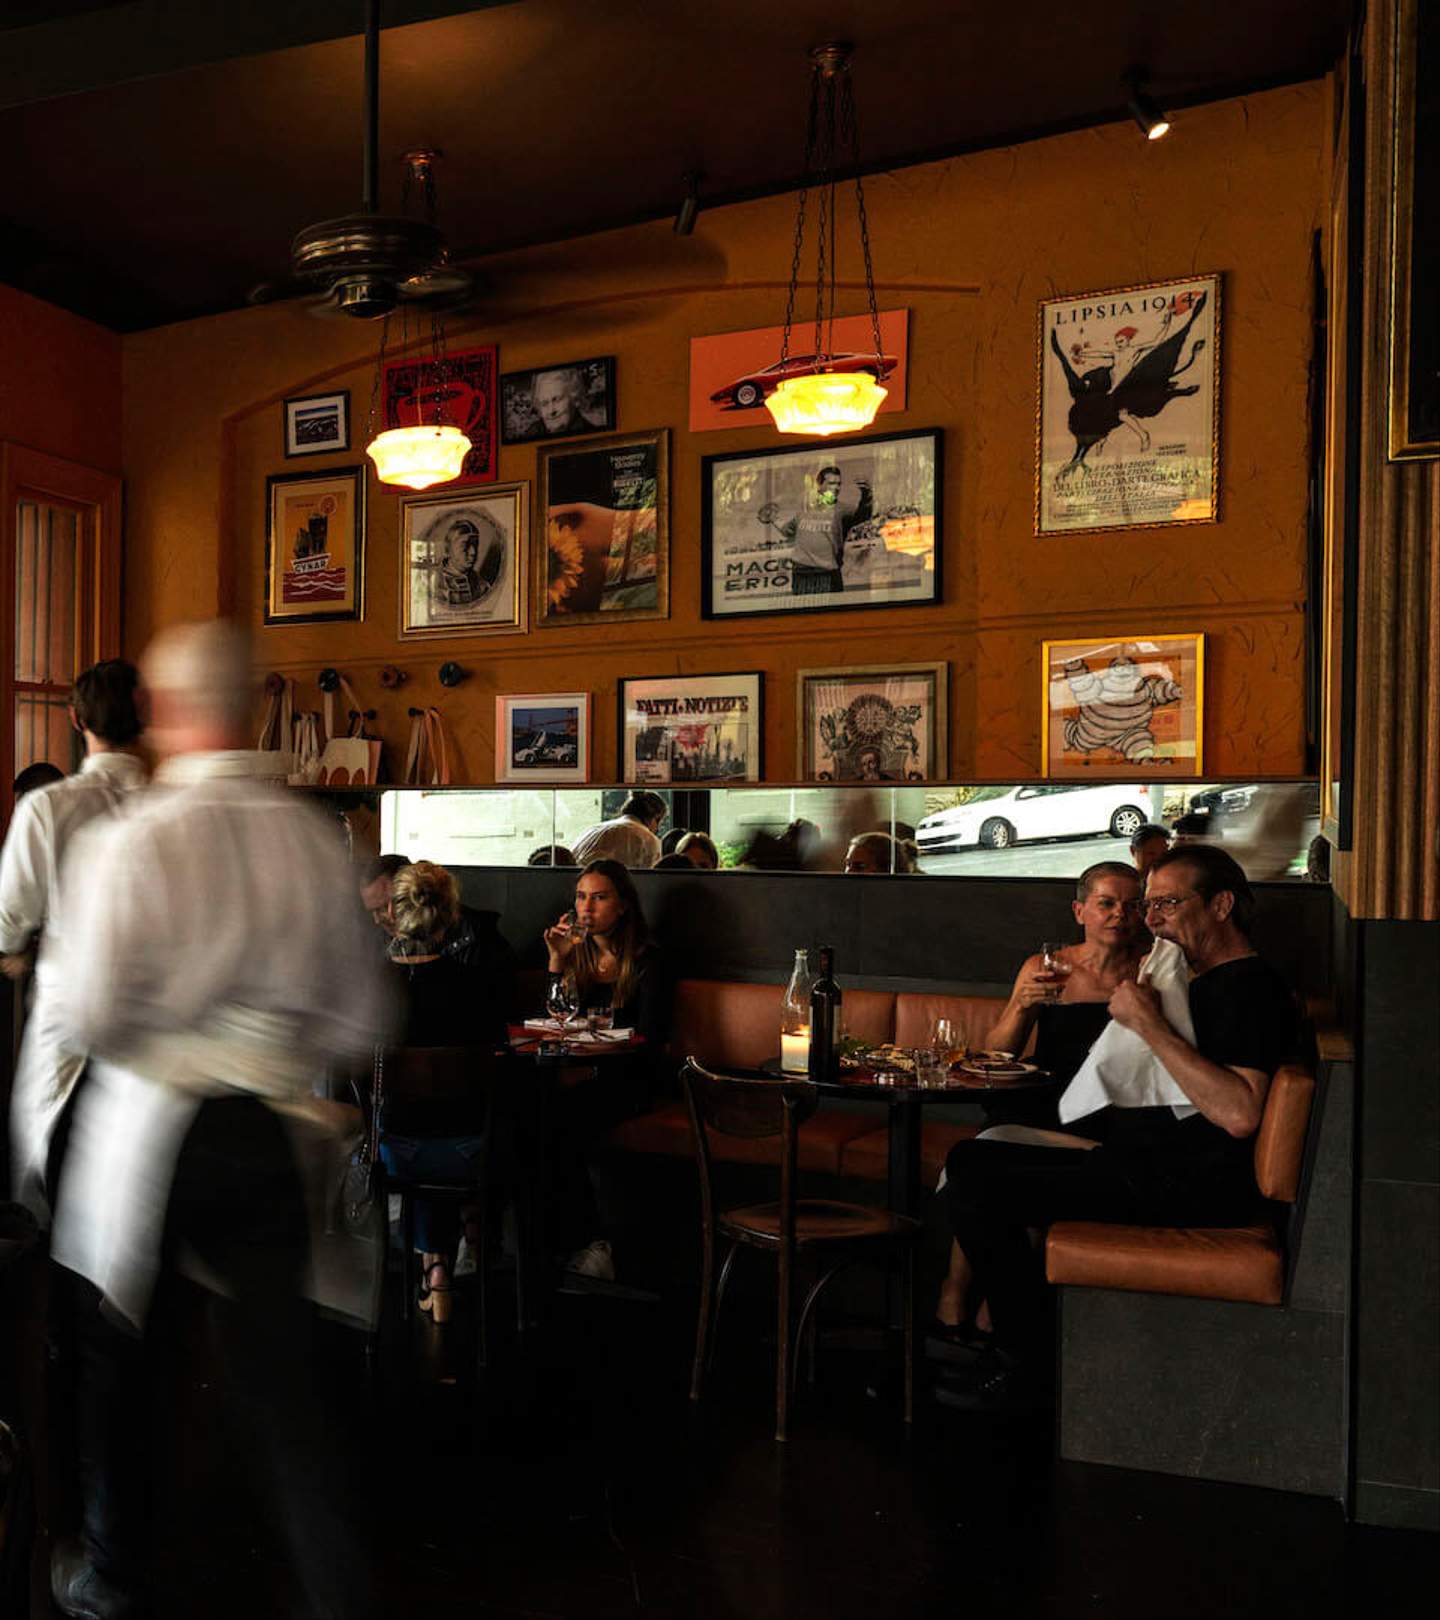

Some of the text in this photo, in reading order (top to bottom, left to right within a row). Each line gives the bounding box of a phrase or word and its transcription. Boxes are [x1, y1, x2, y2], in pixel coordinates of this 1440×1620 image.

[1056, 292, 1195, 325] LIPSIA 1914
[295, 560, 325, 572] CYNAR
[726, 558, 795, 577] MAGO
[725, 576, 790, 591] ERIO
